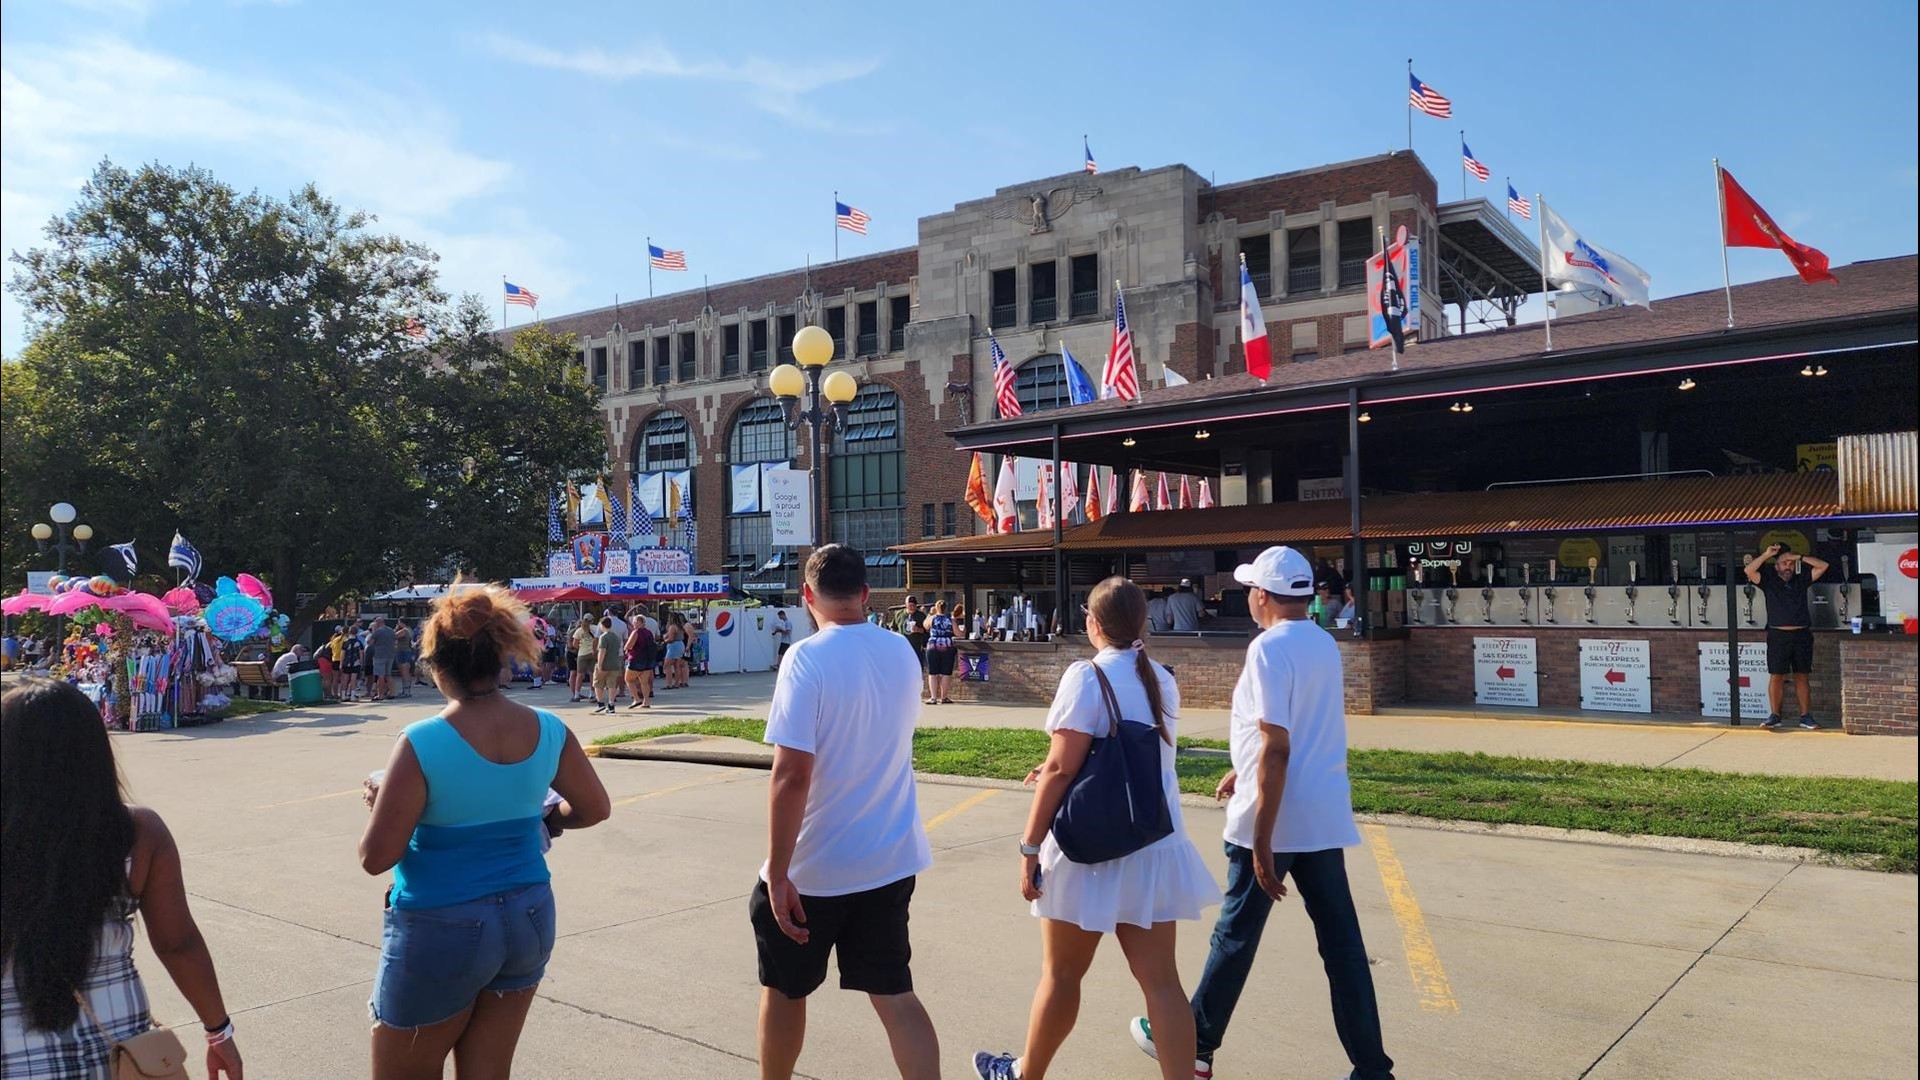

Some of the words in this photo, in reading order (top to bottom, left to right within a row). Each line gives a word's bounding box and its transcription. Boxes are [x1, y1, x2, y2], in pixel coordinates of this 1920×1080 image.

[1410, 249, 1418, 281] SUPER
[1410, 284, 1418, 310] CHILL
[774, 493, 797, 502] Google
[1304, 488, 1344, 499] ENTRY
[612, 564, 628, 574] BARS
[639, 558, 689, 574] TWINKIES
[1420, 560, 1461, 568] Express
[654, 581, 690, 593] CANDY
[693, 581, 719, 593] BARS
